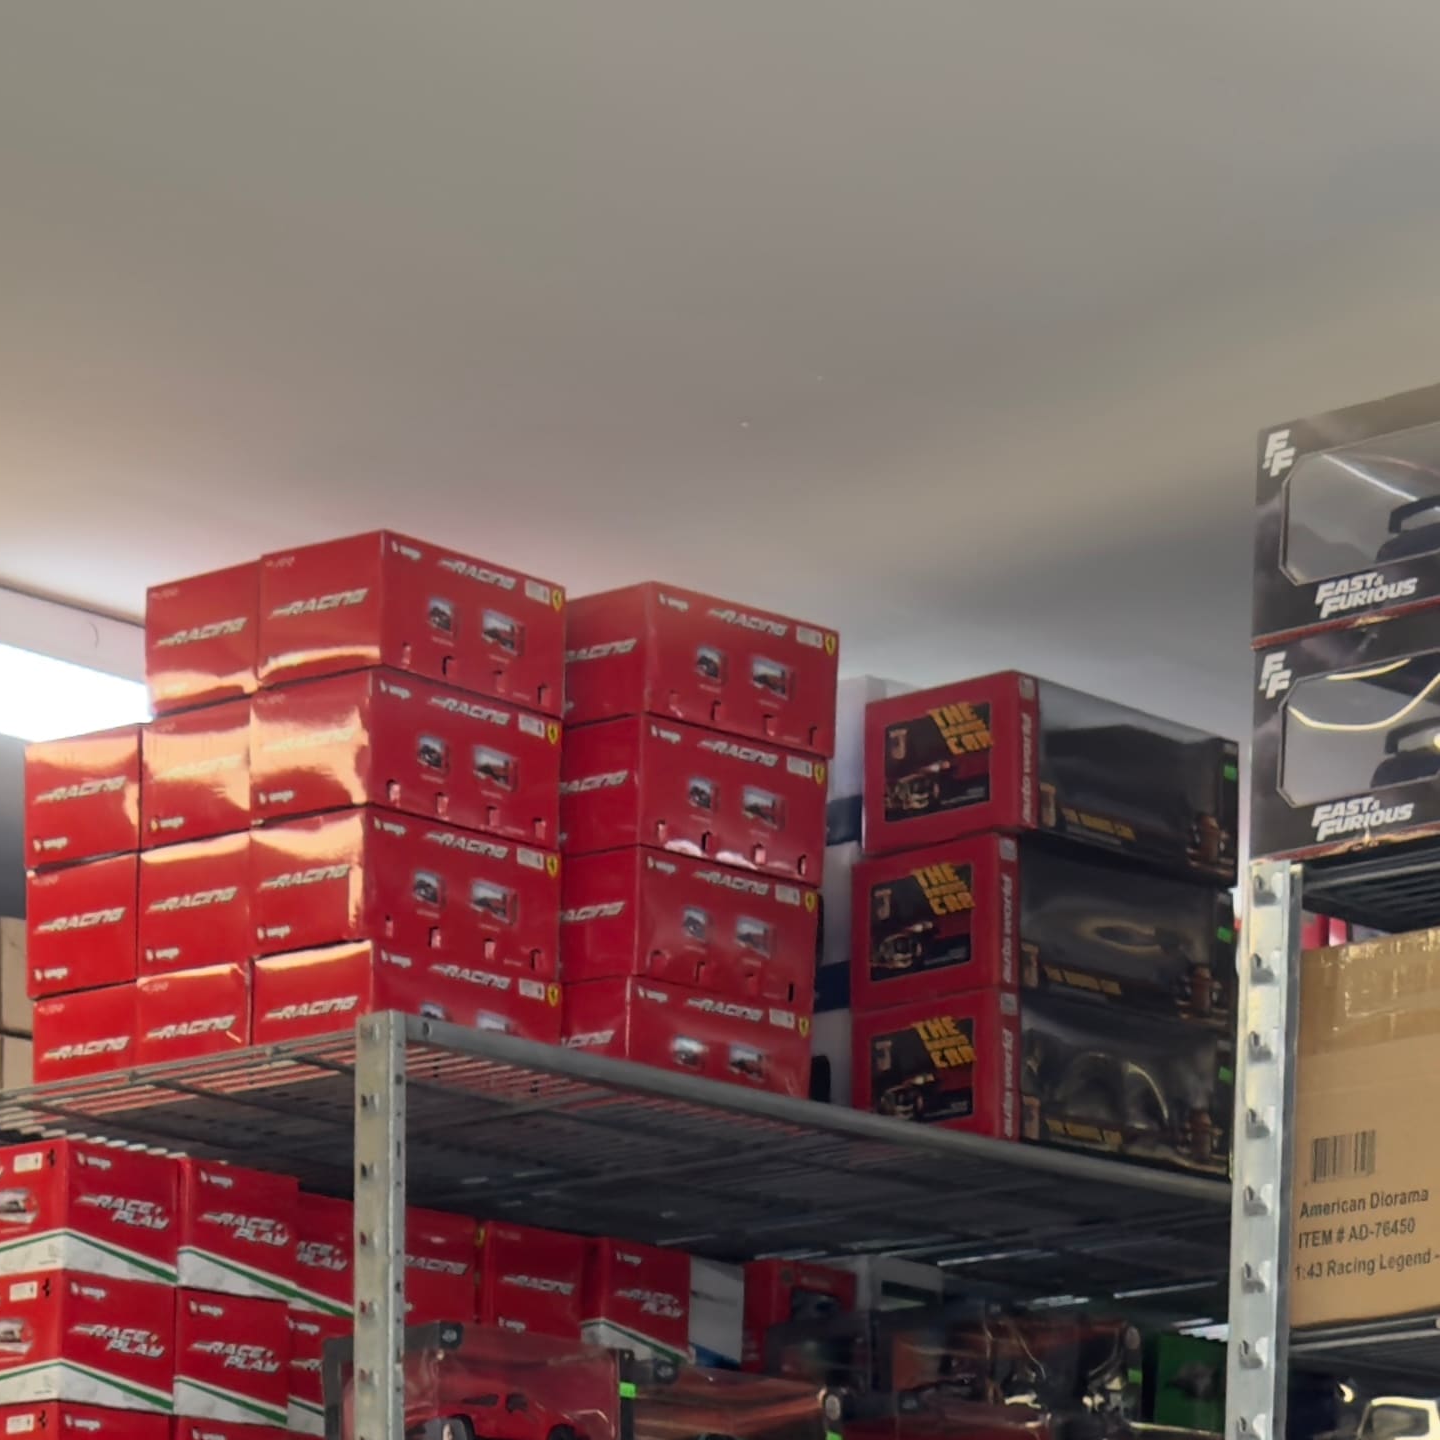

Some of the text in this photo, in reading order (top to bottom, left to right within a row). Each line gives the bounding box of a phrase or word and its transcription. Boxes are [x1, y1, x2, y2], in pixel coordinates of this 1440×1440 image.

[1316, 573, 1374, 604] FAST
[1320, 577, 1418, 619] FURIOUS
[287, 588, 368, 616] RACING
[171, 618, 247, 646] RACING
[927, 701, 975, 728] THE
[49, 776, 126, 802] RACING
[1312, 797, 1370, 829] FAST
[1316, 802, 1415, 842] FURIOUS
[273, 864, 350, 890] RACING
[913, 863, 961, 889] THE
[163, 887, 239, 914] RACING
[49, 907, 125, 932] RACING
[278, 995, 358, 1020] RACING
[160, 1016, 235, 1040] RACING
[919, 1016, 963, 1041] THE
[56, 1036, 130, 1061] RACING
[1300, 1188, 1430, 1220] American Diorama
[111, 1208, 170, 1231] PLAY
[233, 1226, 290, 1248] PLAY
[1298, 1216, 1416, 1250] ITEM # AD-76450
[1295, 1248, 1432, 1281] 1:43 Racing Legend
[105, 1338, 166, 1360] PLAY
[224, 1353, 282, 1374] PLAY
